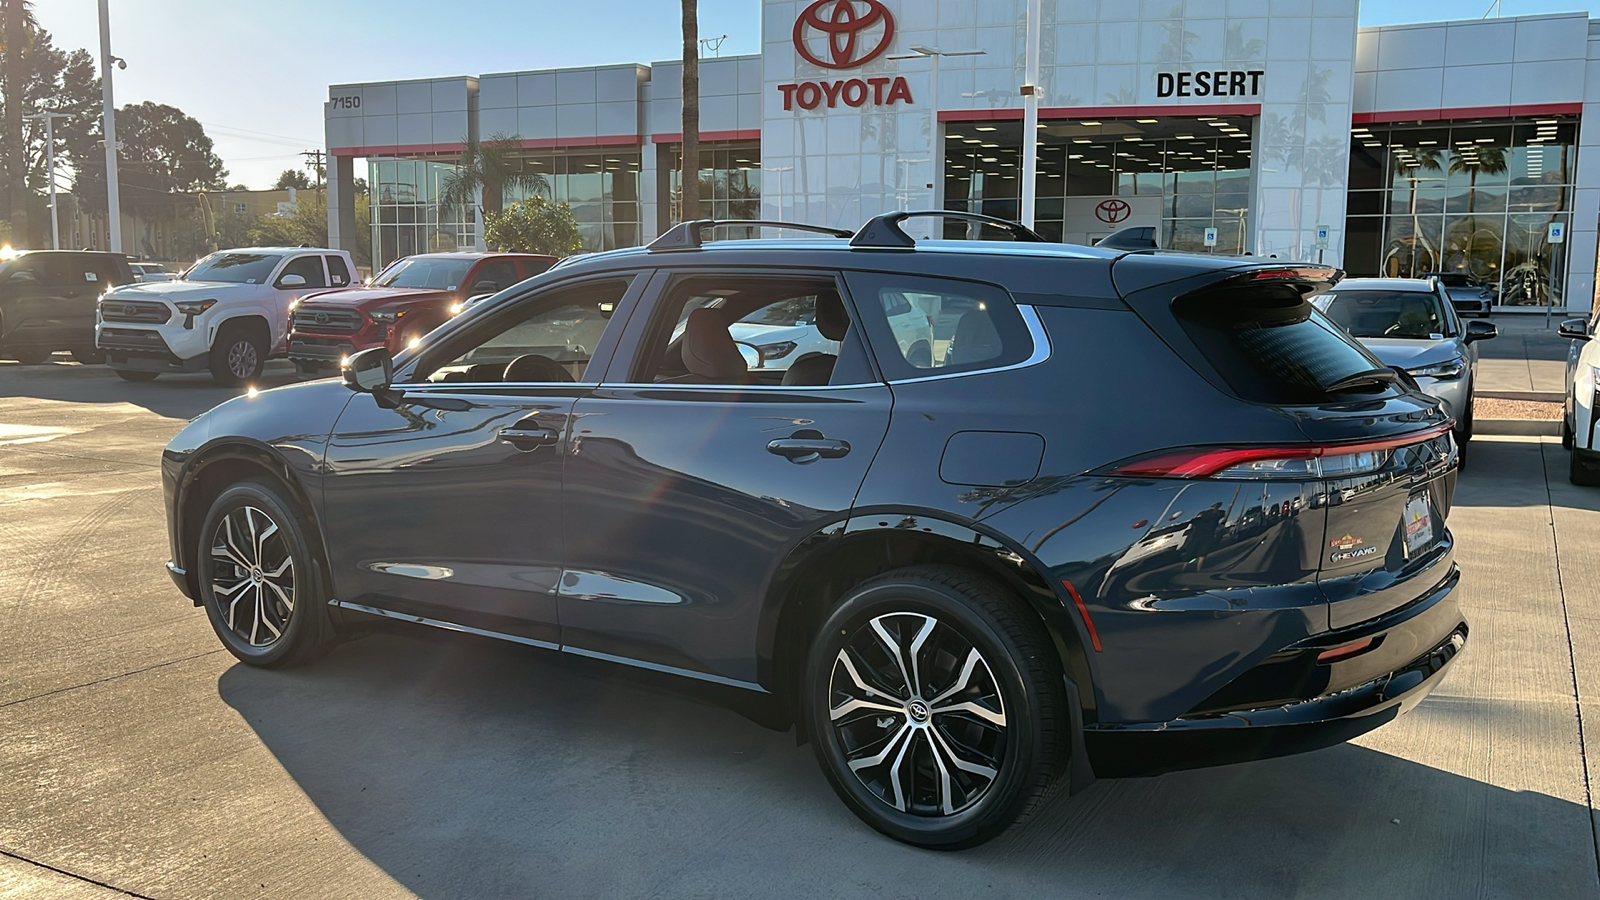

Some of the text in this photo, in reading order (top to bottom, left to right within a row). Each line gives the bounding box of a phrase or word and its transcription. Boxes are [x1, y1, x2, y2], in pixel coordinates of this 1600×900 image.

[777, 76, 914, 111] TOYOTA
[1157, 71, 1264, 97] DESERT
[331, 96, 361, 109] 7150
